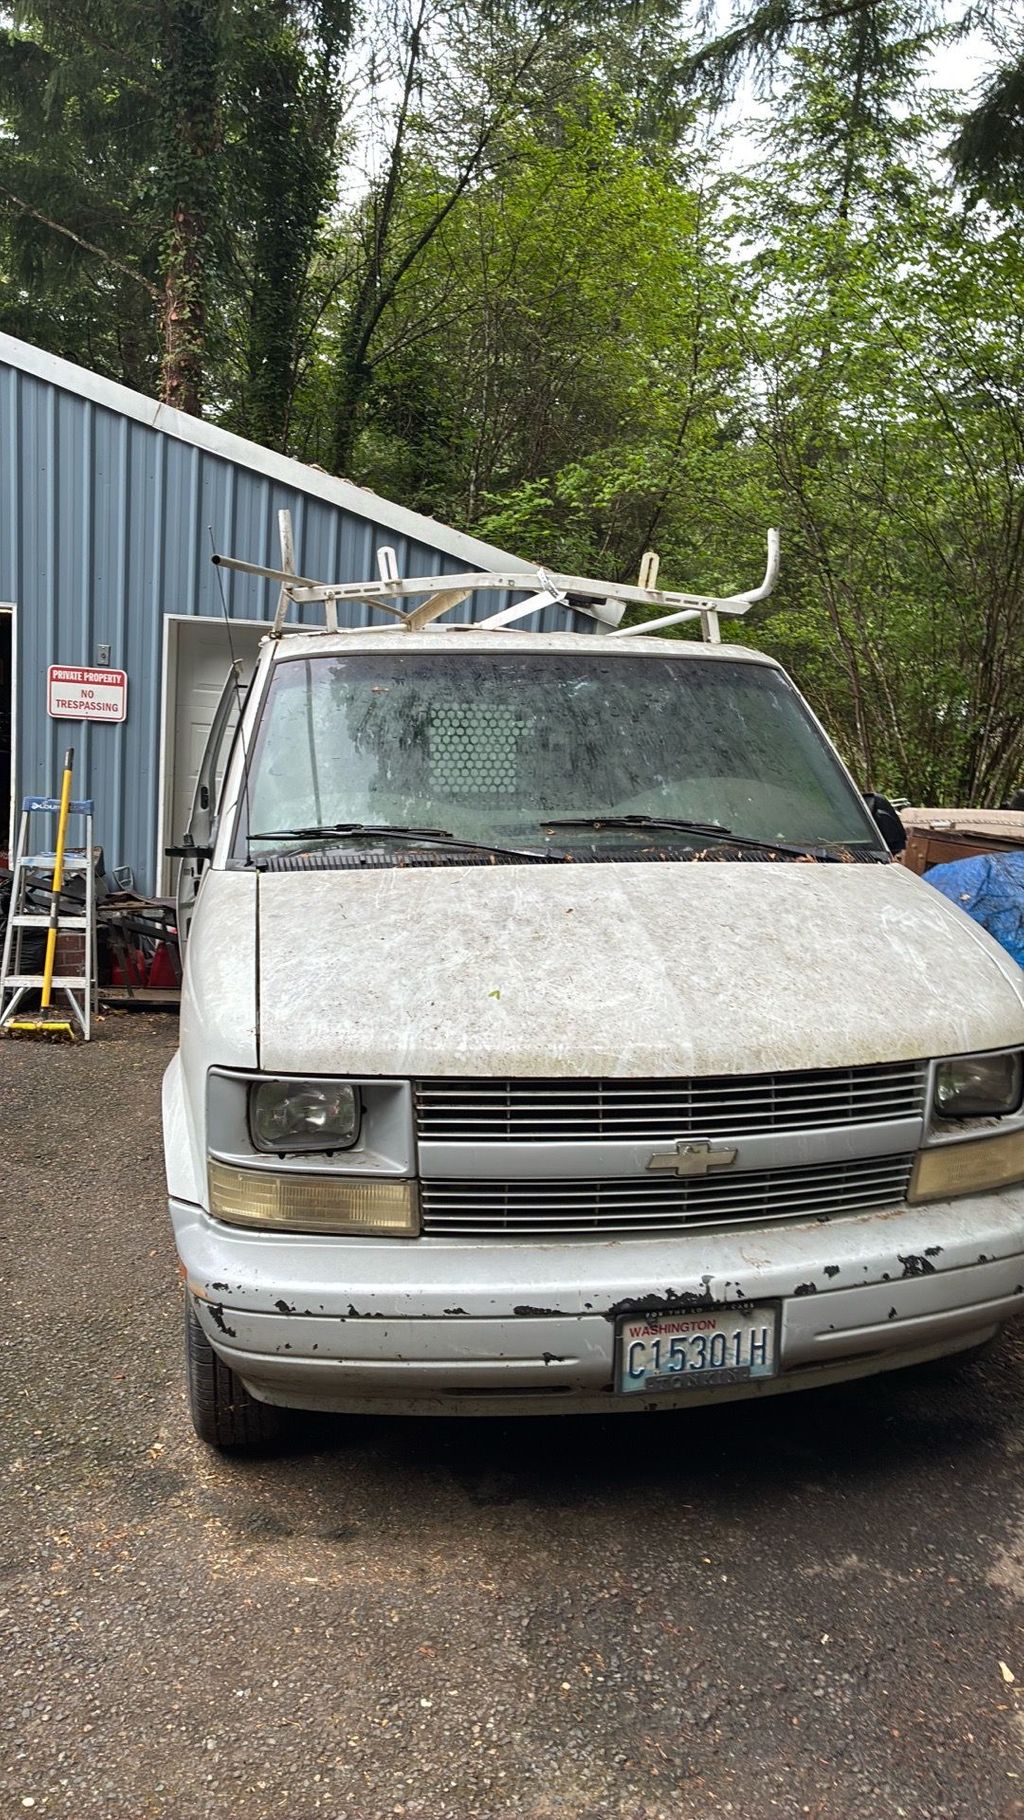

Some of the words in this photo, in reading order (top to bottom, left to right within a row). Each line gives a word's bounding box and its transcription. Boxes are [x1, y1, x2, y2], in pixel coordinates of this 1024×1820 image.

[52, 670, 82, 681] PRIVATE
[84, 672, 122, 684] PROPERTY
[80, 689, 95, 699] NO
[56, 699, 119, 713] TRESPASSING
[629, 1319, 717, 1338] WASHINGTON
[627, 1326, 768, 1379] C15301H
